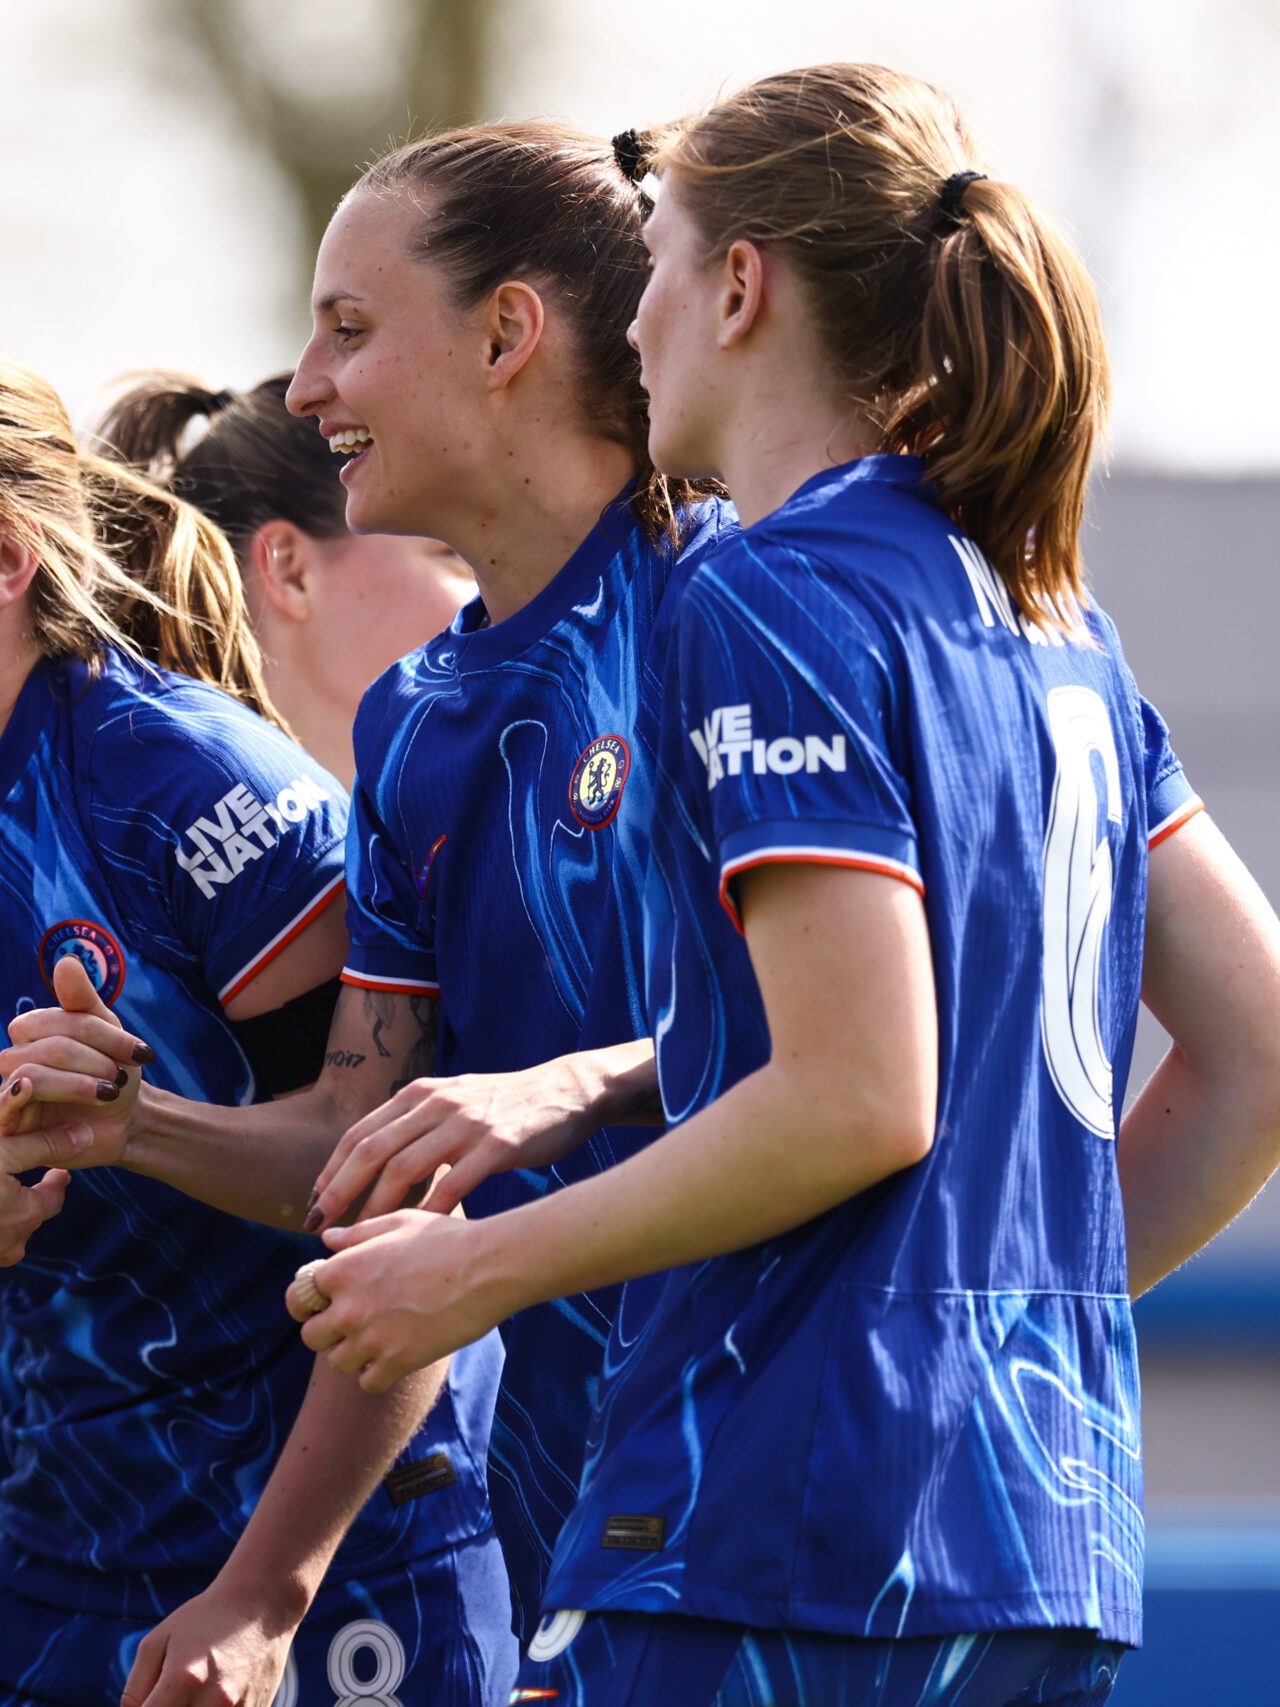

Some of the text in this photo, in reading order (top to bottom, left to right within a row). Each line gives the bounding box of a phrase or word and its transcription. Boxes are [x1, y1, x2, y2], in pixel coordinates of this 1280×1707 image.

[583, 739, 621, 763] CHELSEA
[688, 703, 753, 768] IVE
[707, 735, 847, 791] ATION
[174, 781, 265, 873] LIVE
[189, 773, 331, 901] NATION
[47, 925, 98, 950] CHELSEA
[1041, 685, 1121, 1140] 6
